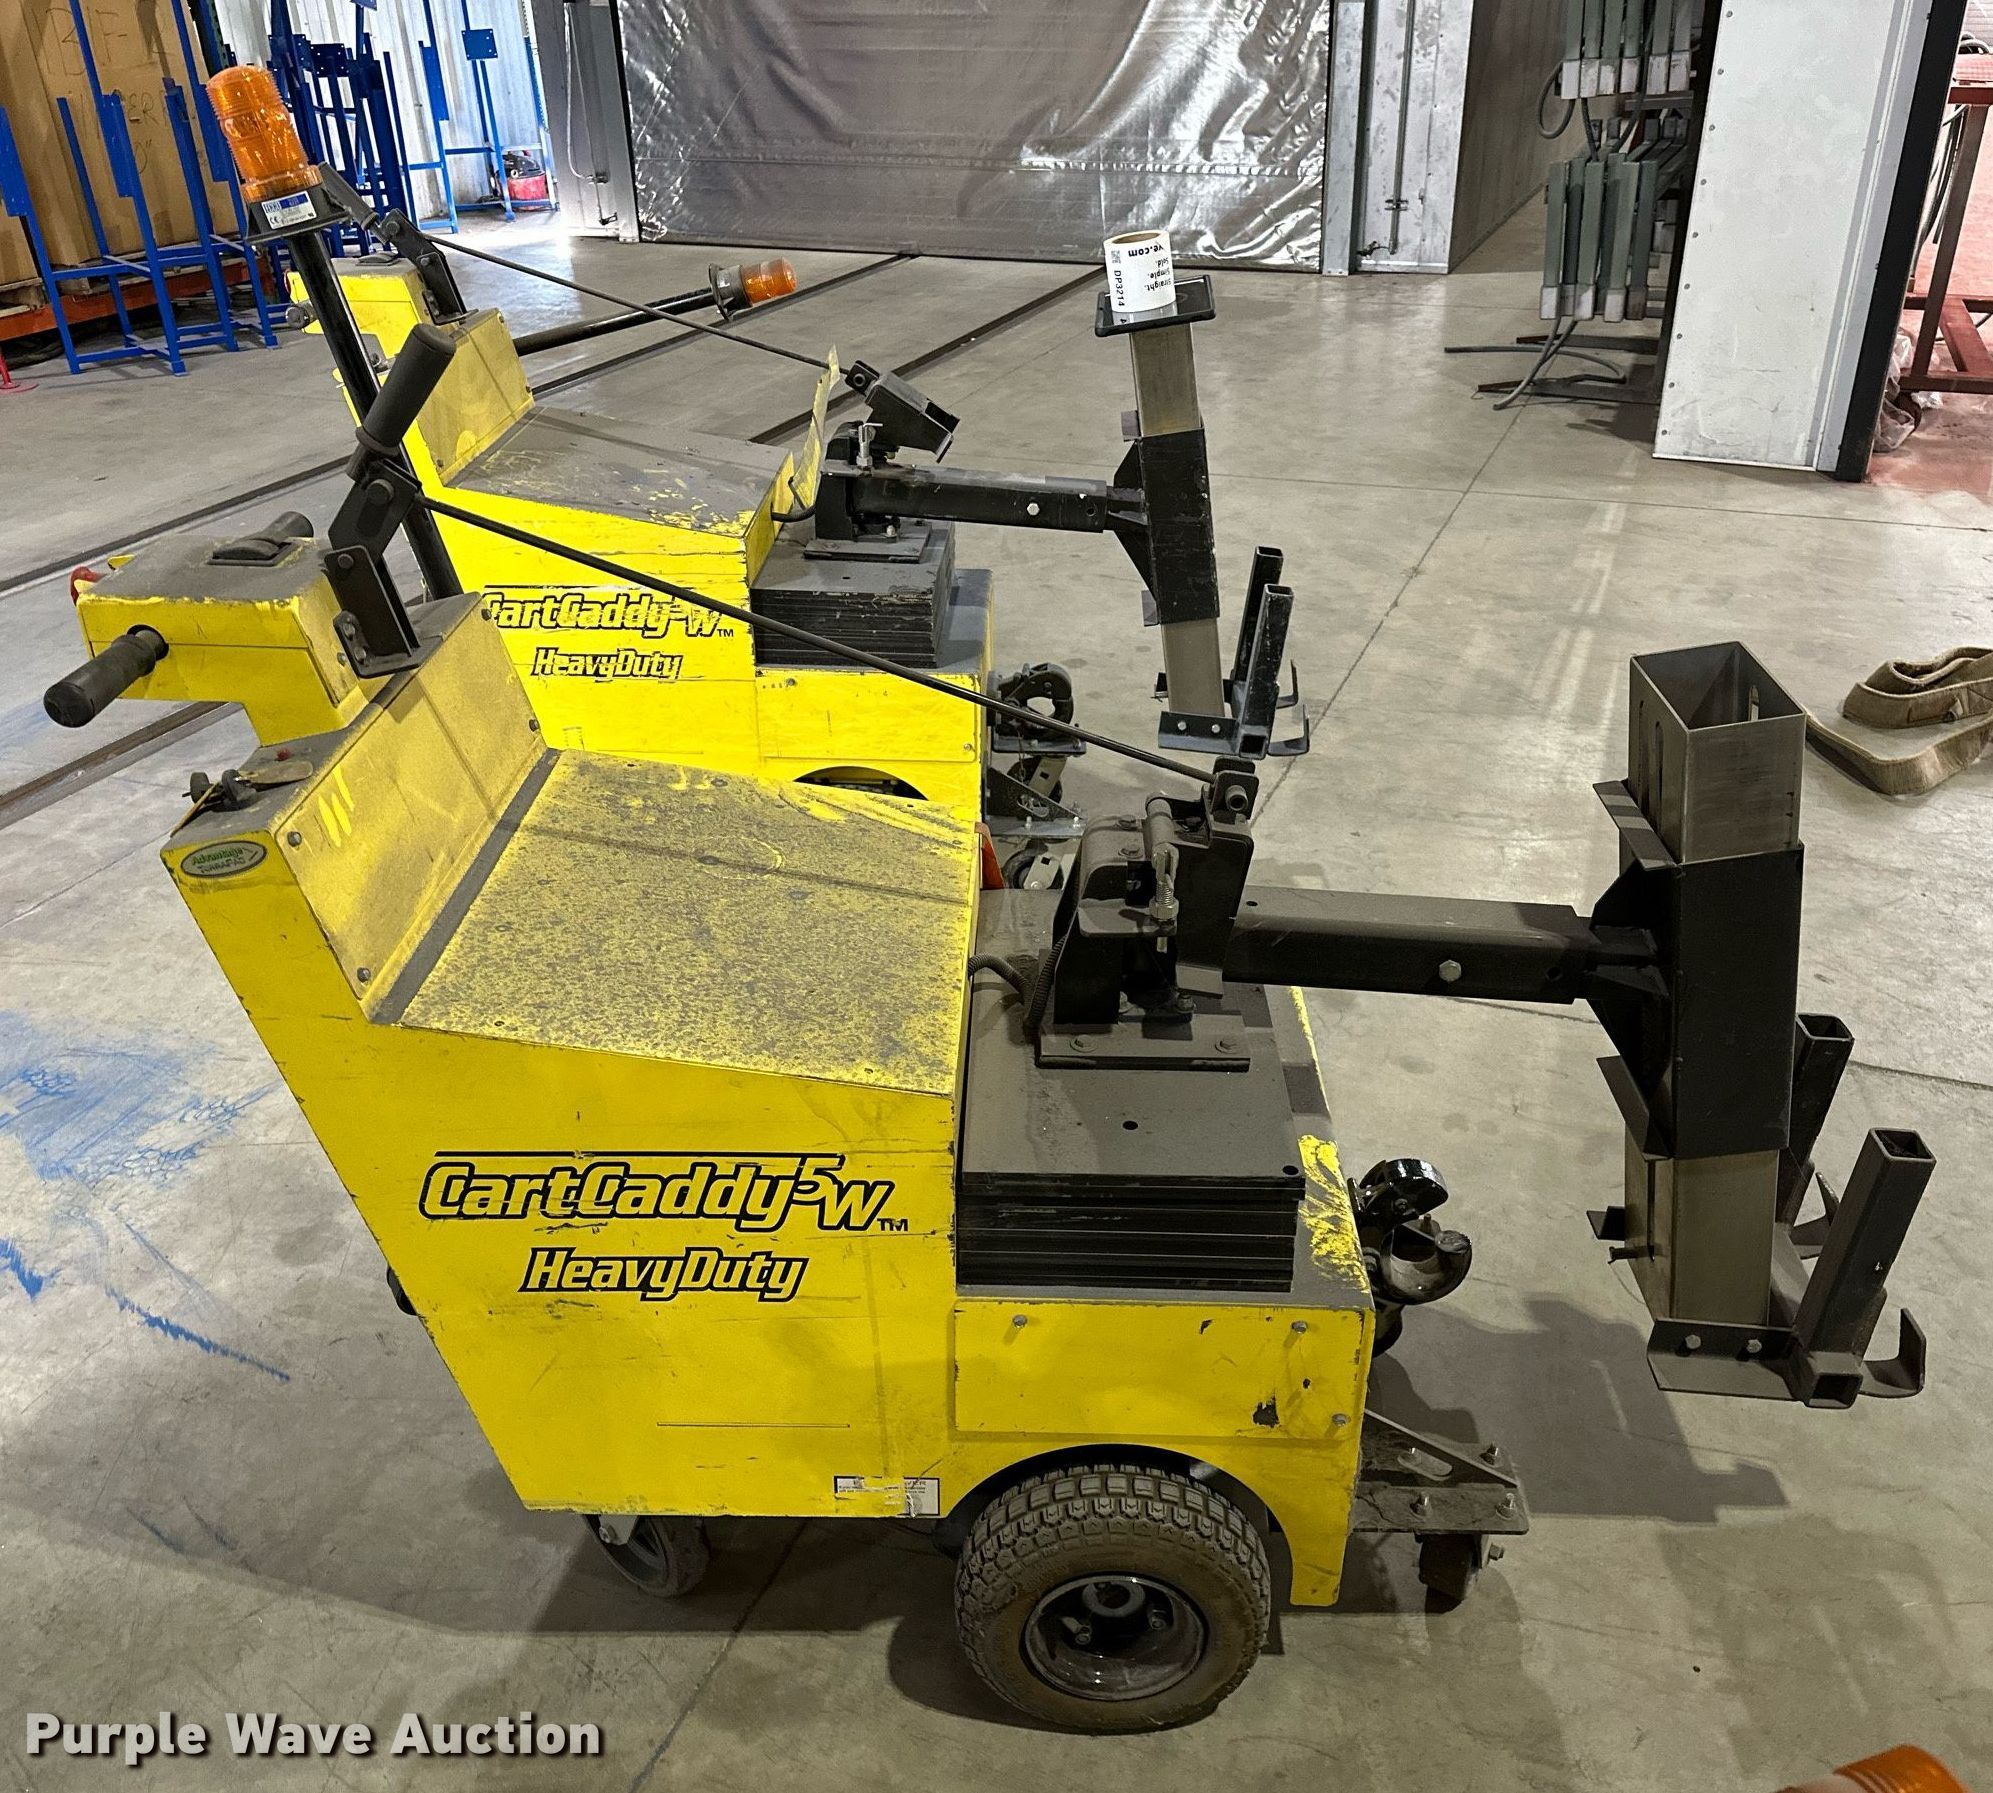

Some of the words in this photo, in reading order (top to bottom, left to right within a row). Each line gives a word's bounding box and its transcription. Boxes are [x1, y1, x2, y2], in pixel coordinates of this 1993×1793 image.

[1114, 270, 1125, 306] DP3214
[531, 647, 684, 683] HeavyDuty
[518, 1247, 810, 1302] HeavyDuty
